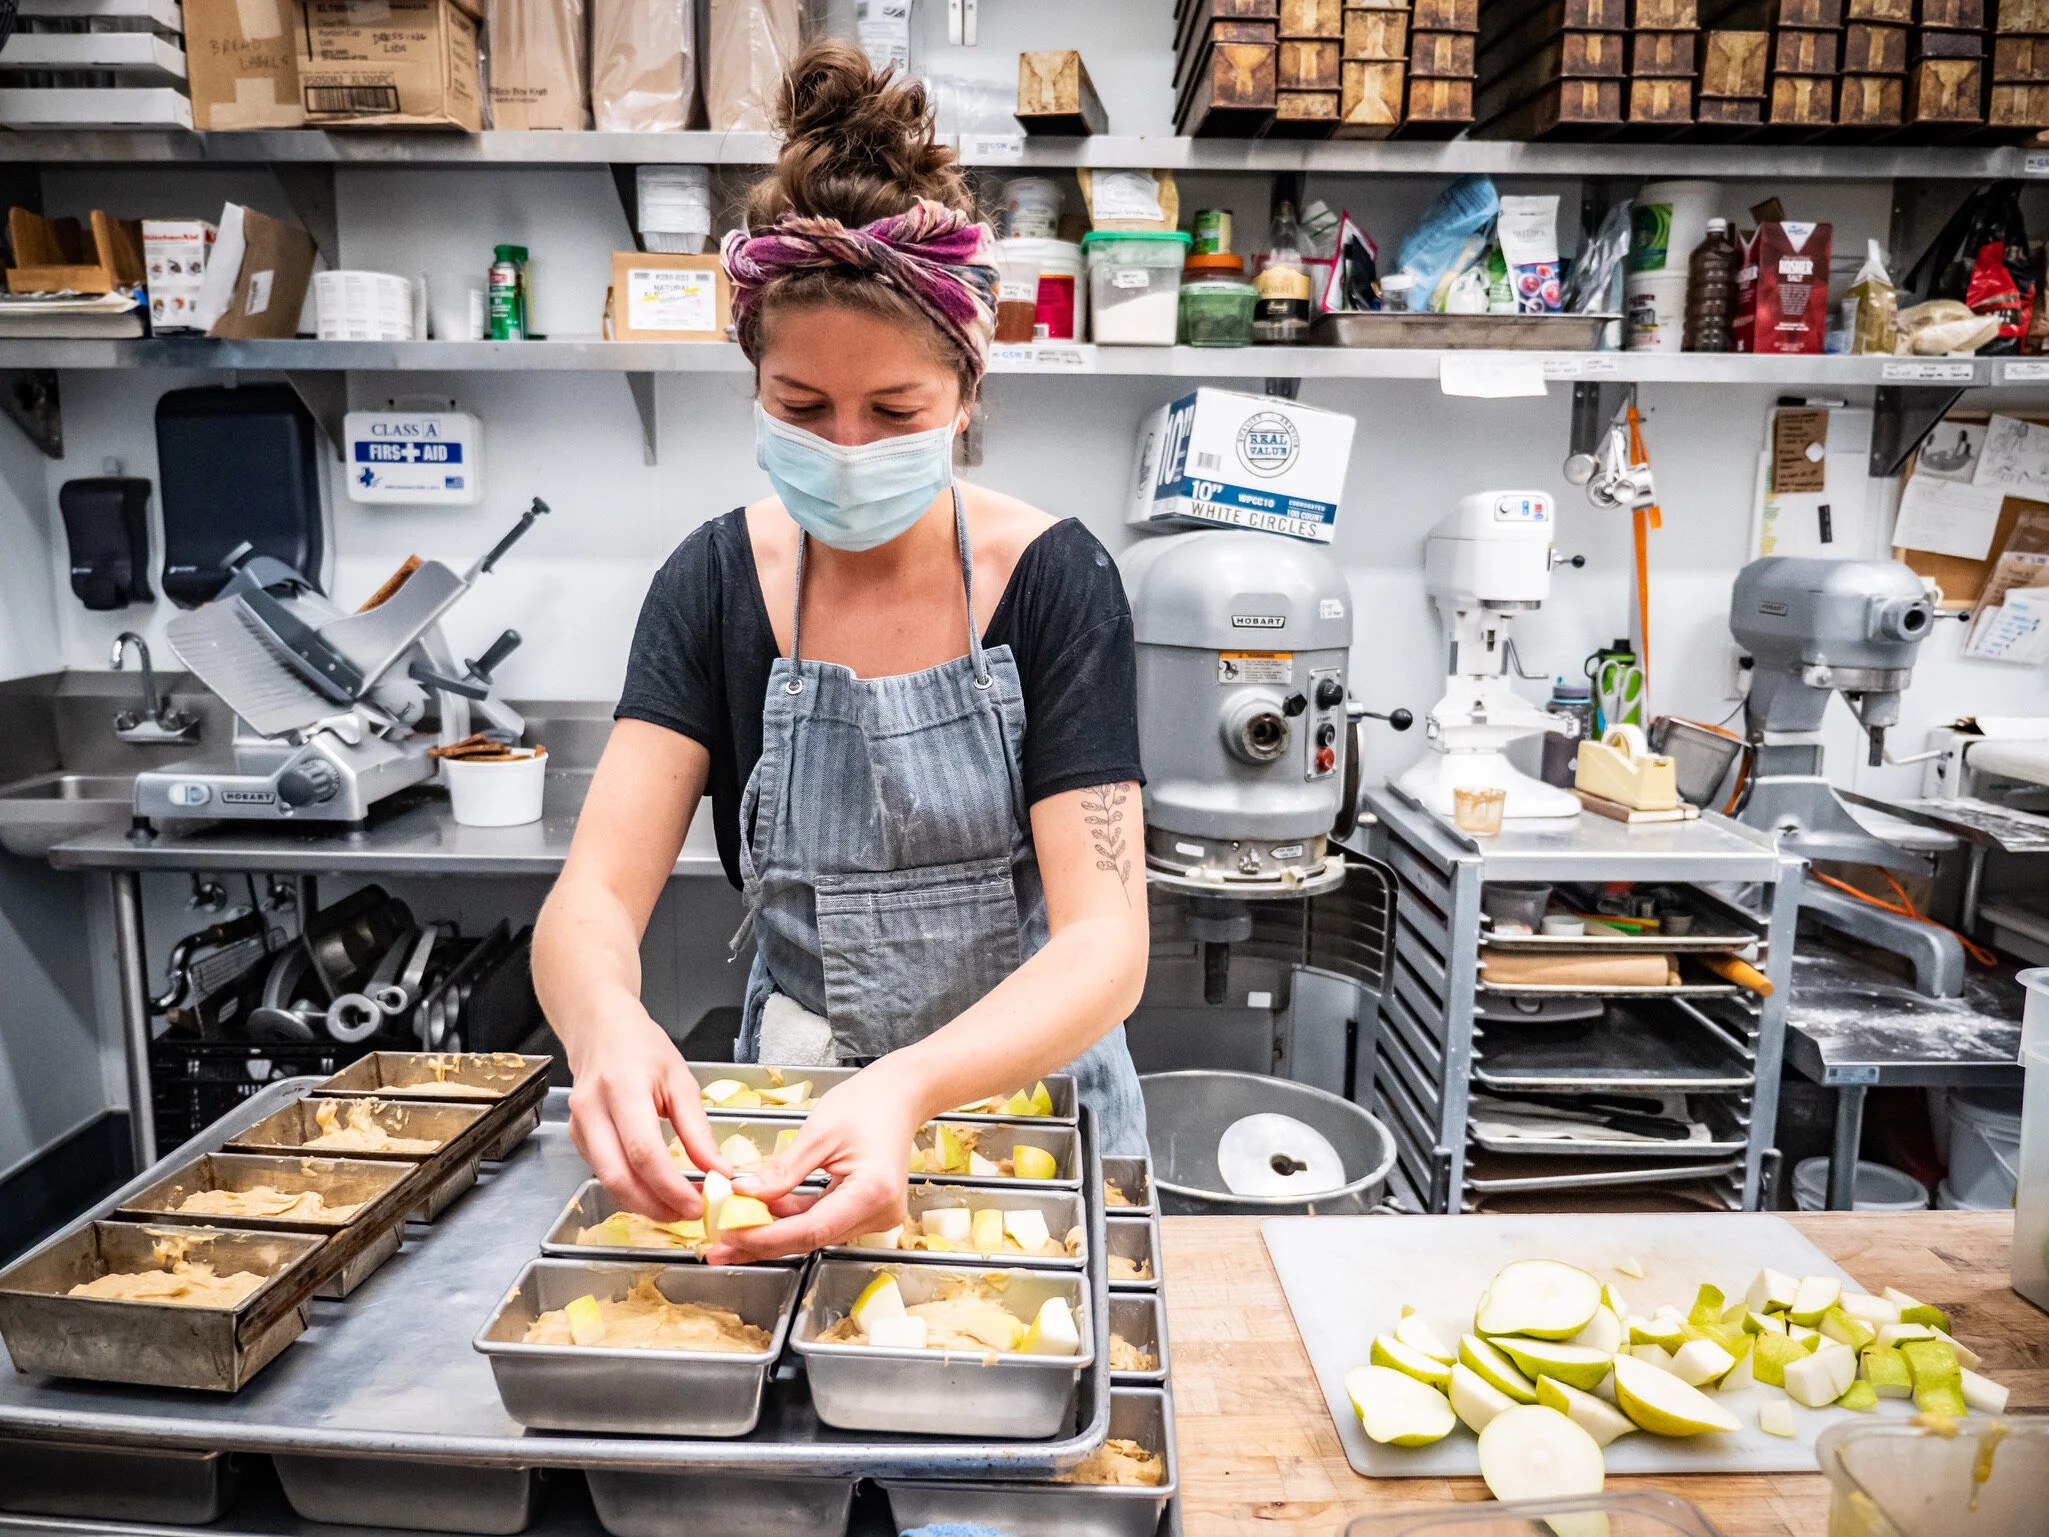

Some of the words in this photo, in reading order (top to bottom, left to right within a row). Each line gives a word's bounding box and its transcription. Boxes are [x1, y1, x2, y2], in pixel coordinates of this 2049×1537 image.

[2036, 157, 2049, 167] GS
[143, 233, 199, 241] KitchenAid
[1001, 351, 1023, 360] GSW
[371, 423, 419, 437] CLASS
[425, 423, 438, 437] A
[1249, 434, 1288, 446] REAL
[422, 444, 448, 462] AID
[1249, 446, 1287, 457] VALUE
[1238, 493, 1275, 509] WPCC10
[1288, 500, 1327, 512] CORRUGATED
[1191, 502, 1243, 524] WHITE
[1249, 512, 1318, 538] CIRCLES
[1287, 509, 1300, 519] 100
[1300, 511, 1324, 523] COUNT
[1236, 617, 1282, 626] HOBART
[226, 793, 272, 801] HOBART
